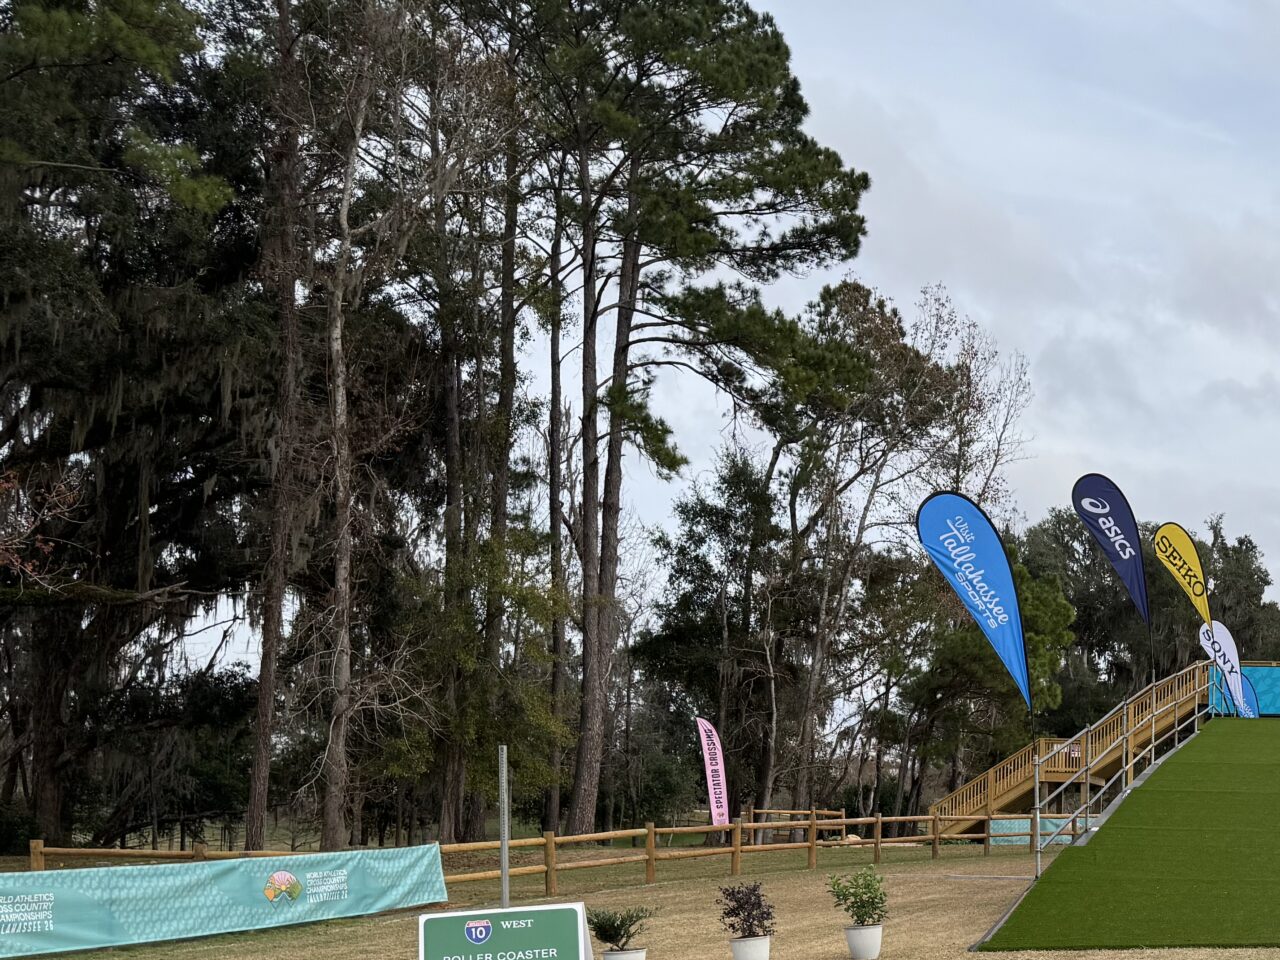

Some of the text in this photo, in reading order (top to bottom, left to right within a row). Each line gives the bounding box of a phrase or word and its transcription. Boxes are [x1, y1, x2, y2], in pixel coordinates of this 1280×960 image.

[954, 515, 976, 543] Visit
[1098, 516, 1136, 560] asics
[939, 519, 1009, 625] Tallahassee
[1156, 535, 1205, 597] SEIKO
[955, 572, 999, 629] SPORTS
[1202, 629, 1239, 676] SONY
[704, 728, 724, 809] SPECTATOR CROSSING
[14, 893, 55, 902] ATHLETICS
[14, 902, 54, 912] COUNTRY
[45, 920, 54, 930] 26
[471, 919, 534, 939] 10 WEST
